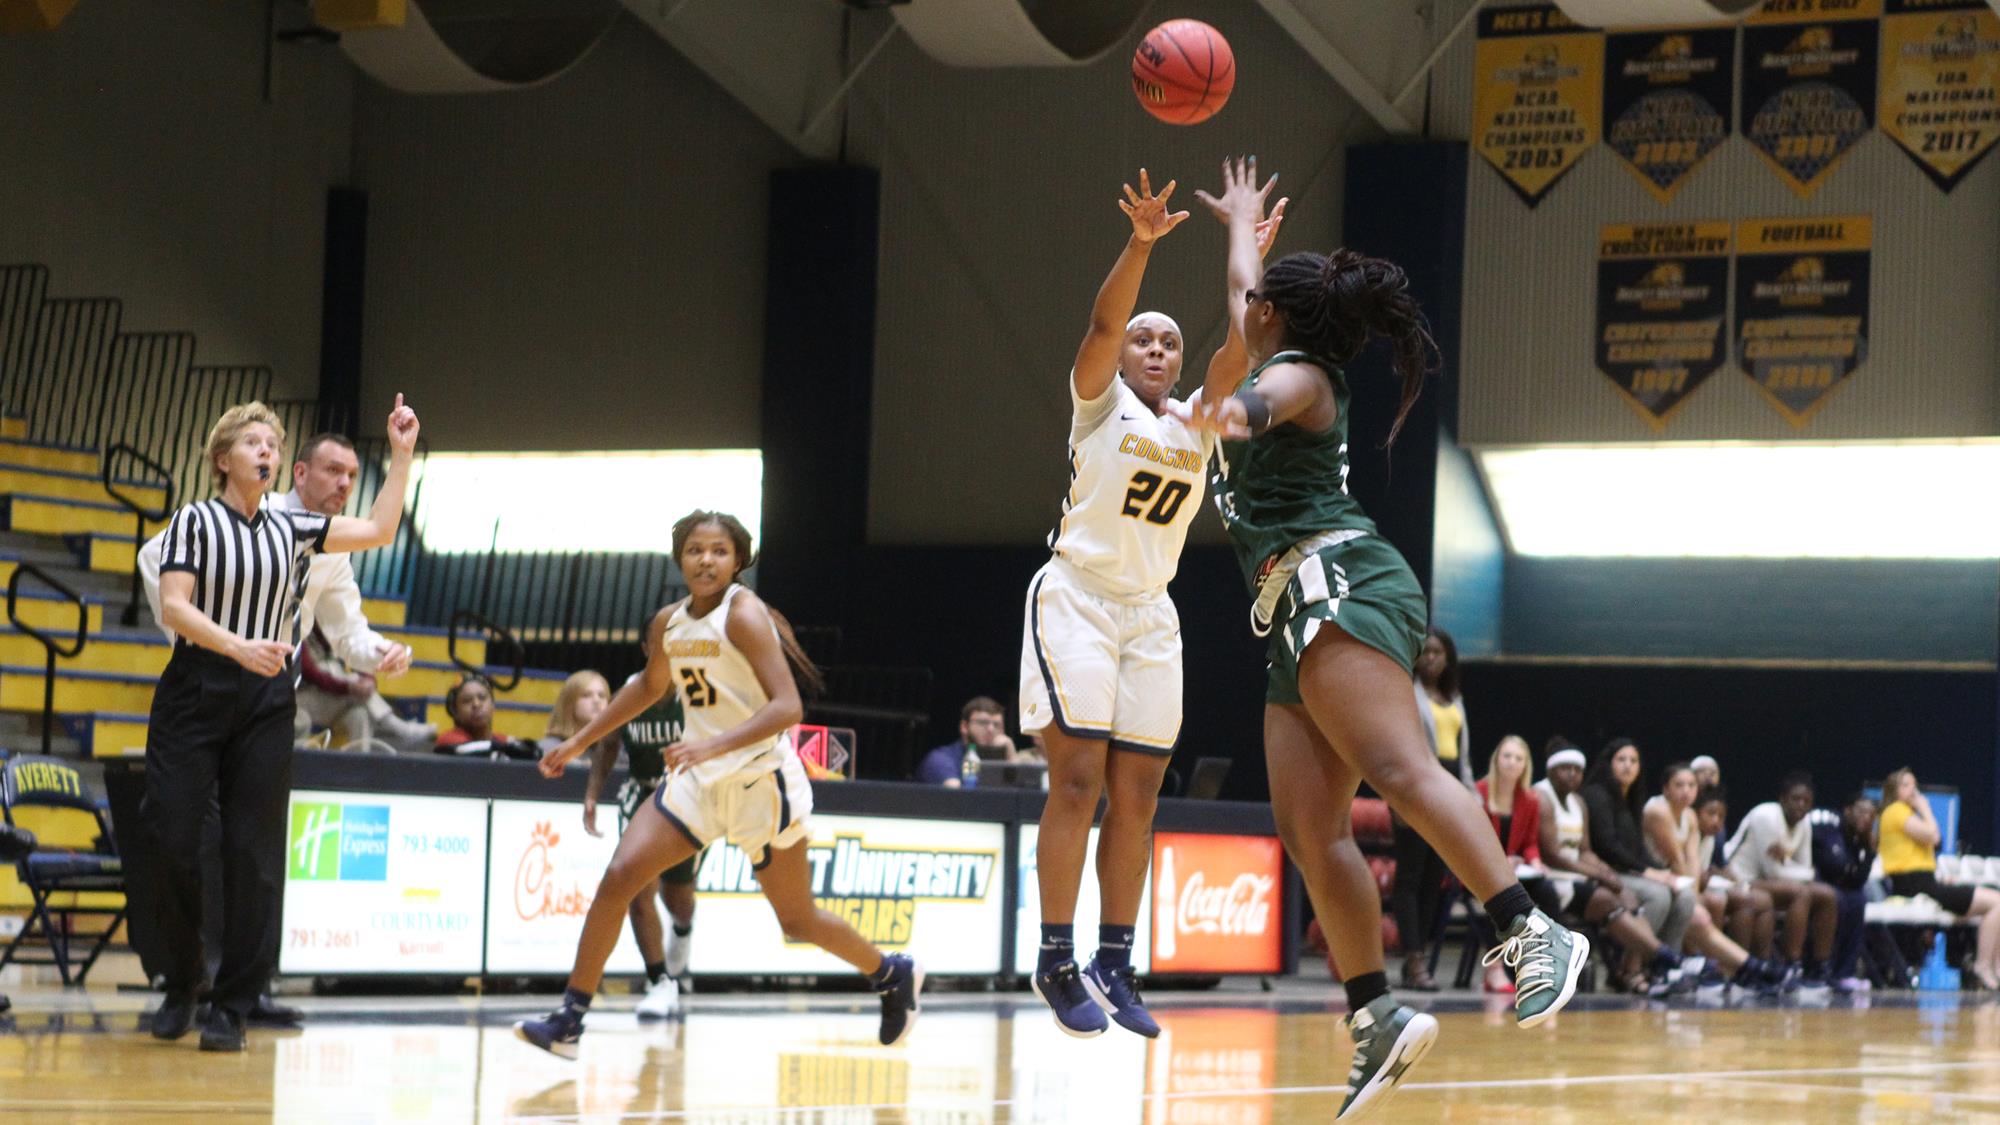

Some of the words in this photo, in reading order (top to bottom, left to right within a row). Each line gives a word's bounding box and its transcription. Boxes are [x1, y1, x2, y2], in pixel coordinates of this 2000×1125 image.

[1513, 90, 1559, 106] NCAA
[1905, 87, 1995, 104] NATIONAL
[1494, 109, 1577, 126] NATIONAL
[1484, 128, 1586, 148] CHAMPIONS
[1921, 130, 1981, 152] 2017
[1504, 149, 1565, 169] 2003
[1760, 222, 1846, 243] FOOTBALL
[1120, 469, 1192, 526] 20
[680, 667, 717, 706] 21
[628, 719, 683, 744] WILLIA
[14, 761, 81, 798] AVERETT
[343, 835, 386, 857] Express
[402, 833, 471, 855] 793-4000
[370, 911, 471, 931] COURTYARD
[290, 928, 361, 949] 791-2661
